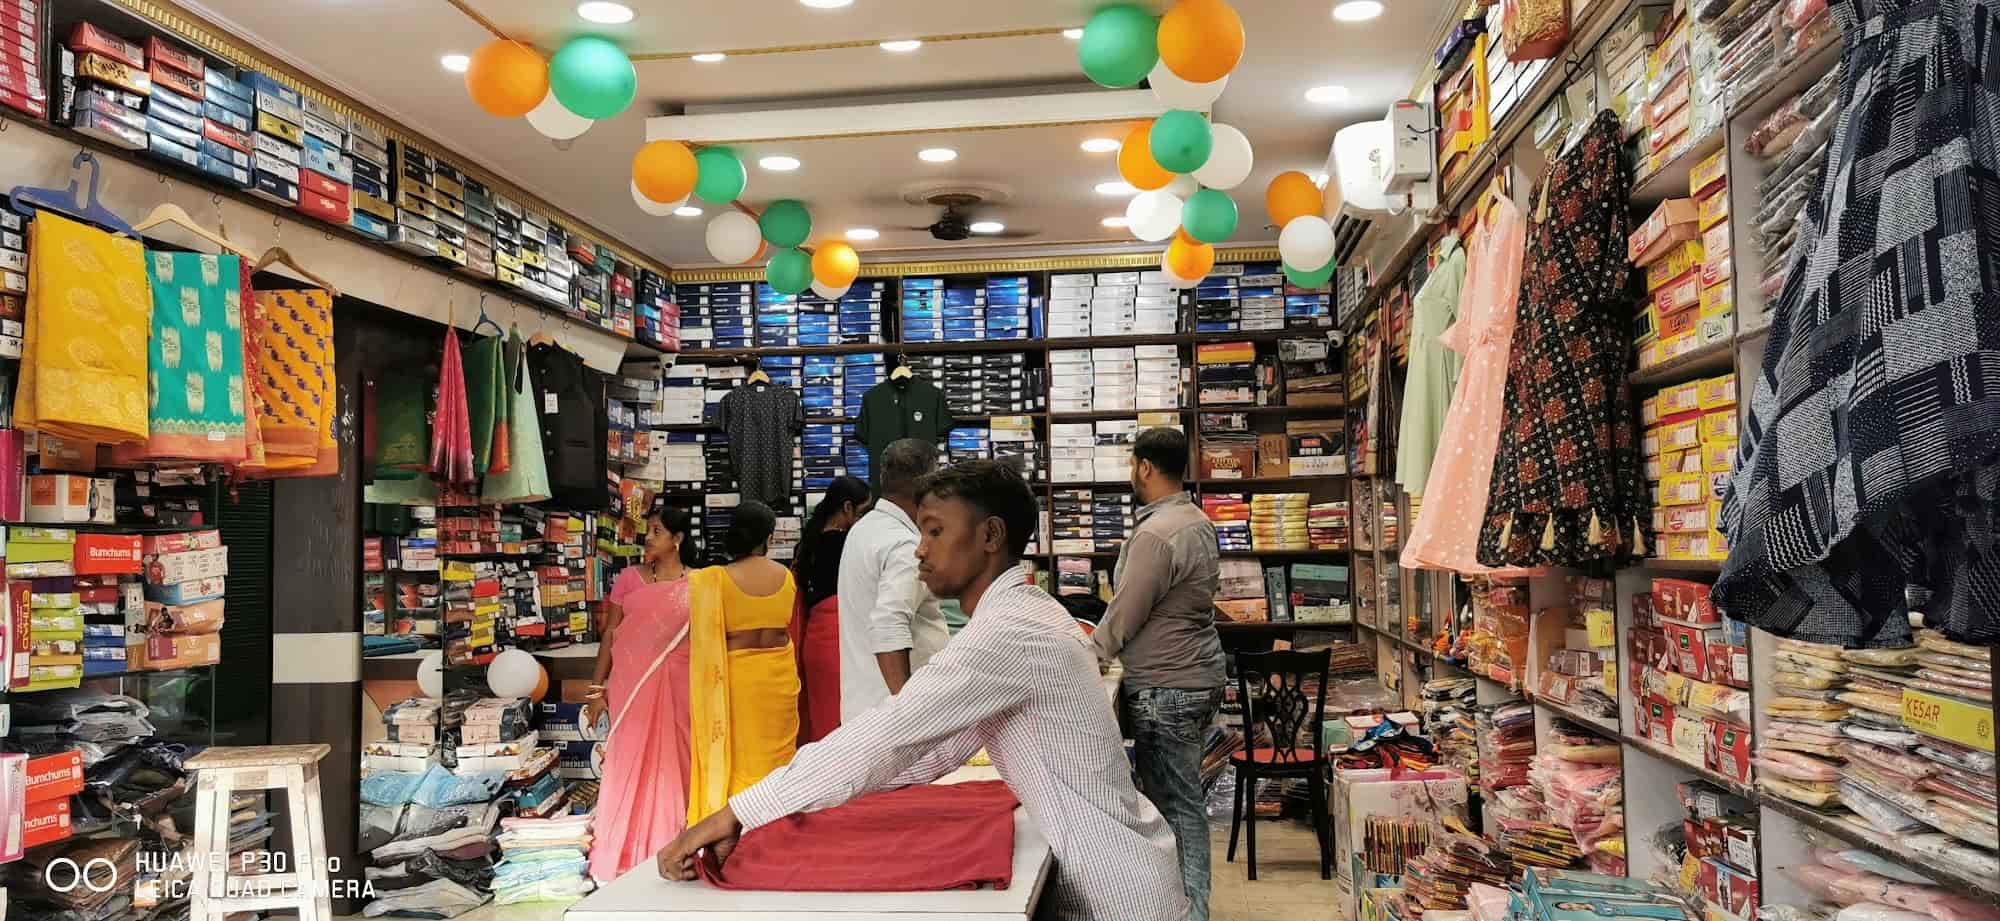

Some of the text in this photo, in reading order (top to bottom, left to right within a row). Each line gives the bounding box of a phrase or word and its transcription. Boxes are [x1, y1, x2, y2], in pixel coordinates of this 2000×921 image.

[90, 547, 131, 557] Bumchums
[1905, 697, 1941, 721] KESAR
[25, 767, 72, 786] Bumchums
